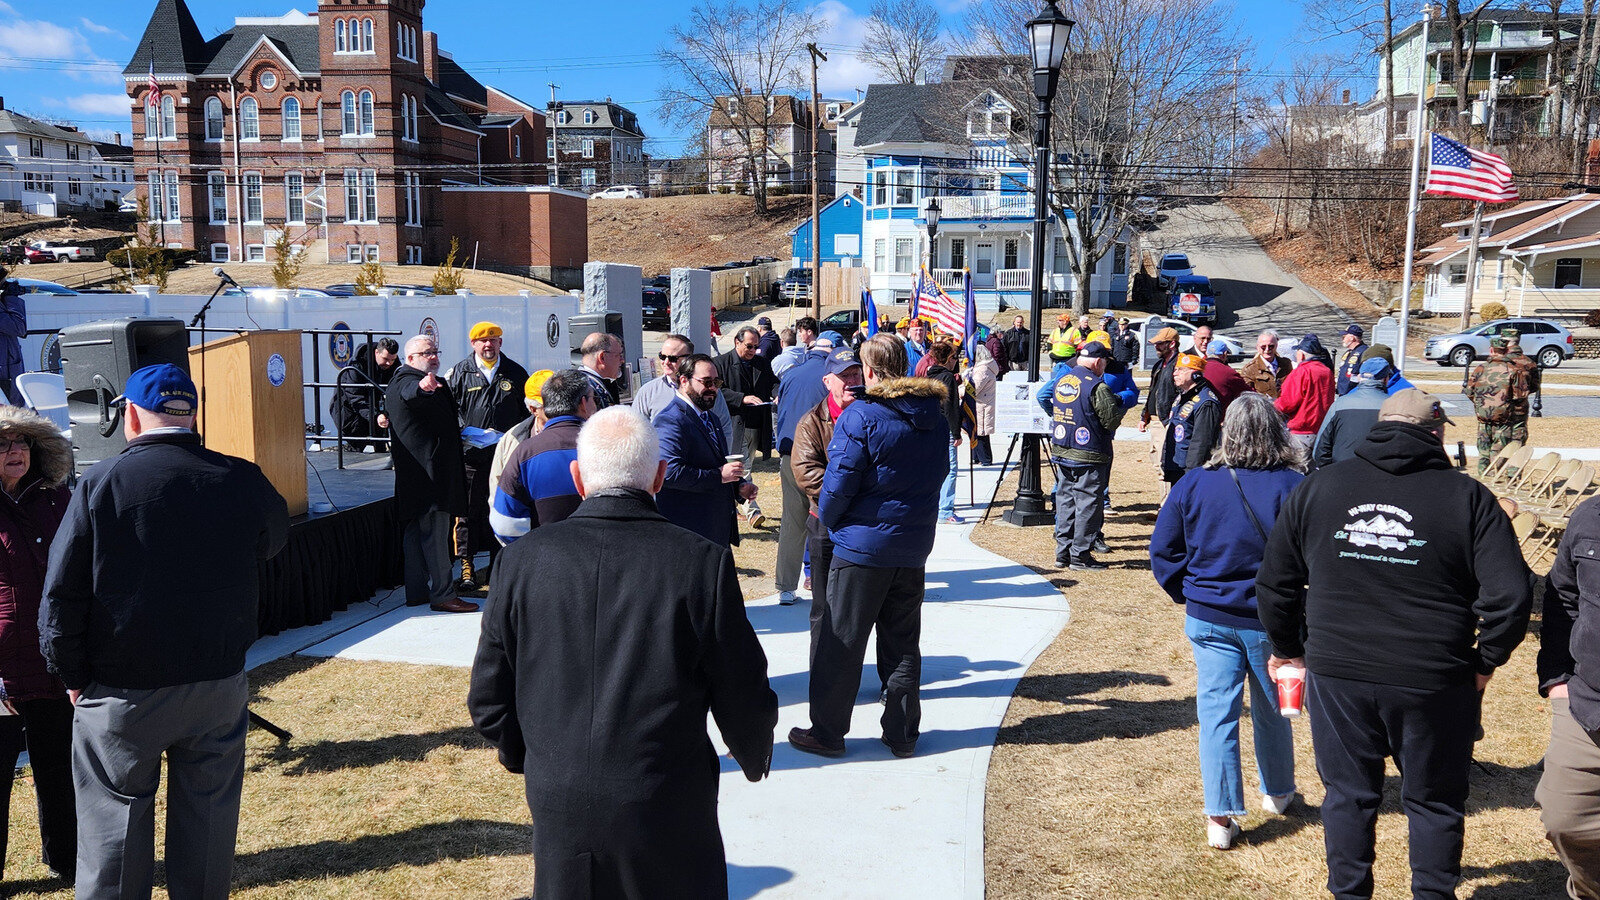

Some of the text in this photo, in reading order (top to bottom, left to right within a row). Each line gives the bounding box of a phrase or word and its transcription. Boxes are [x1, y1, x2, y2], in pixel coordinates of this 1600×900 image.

[1347, 503, 1413, 522] HI-WAY CAMPERS
[1339, 551, 1360, 560] Family
[1360, 553, 1383, 562] Owned
[1388, 557, 1420, 566] Operated
